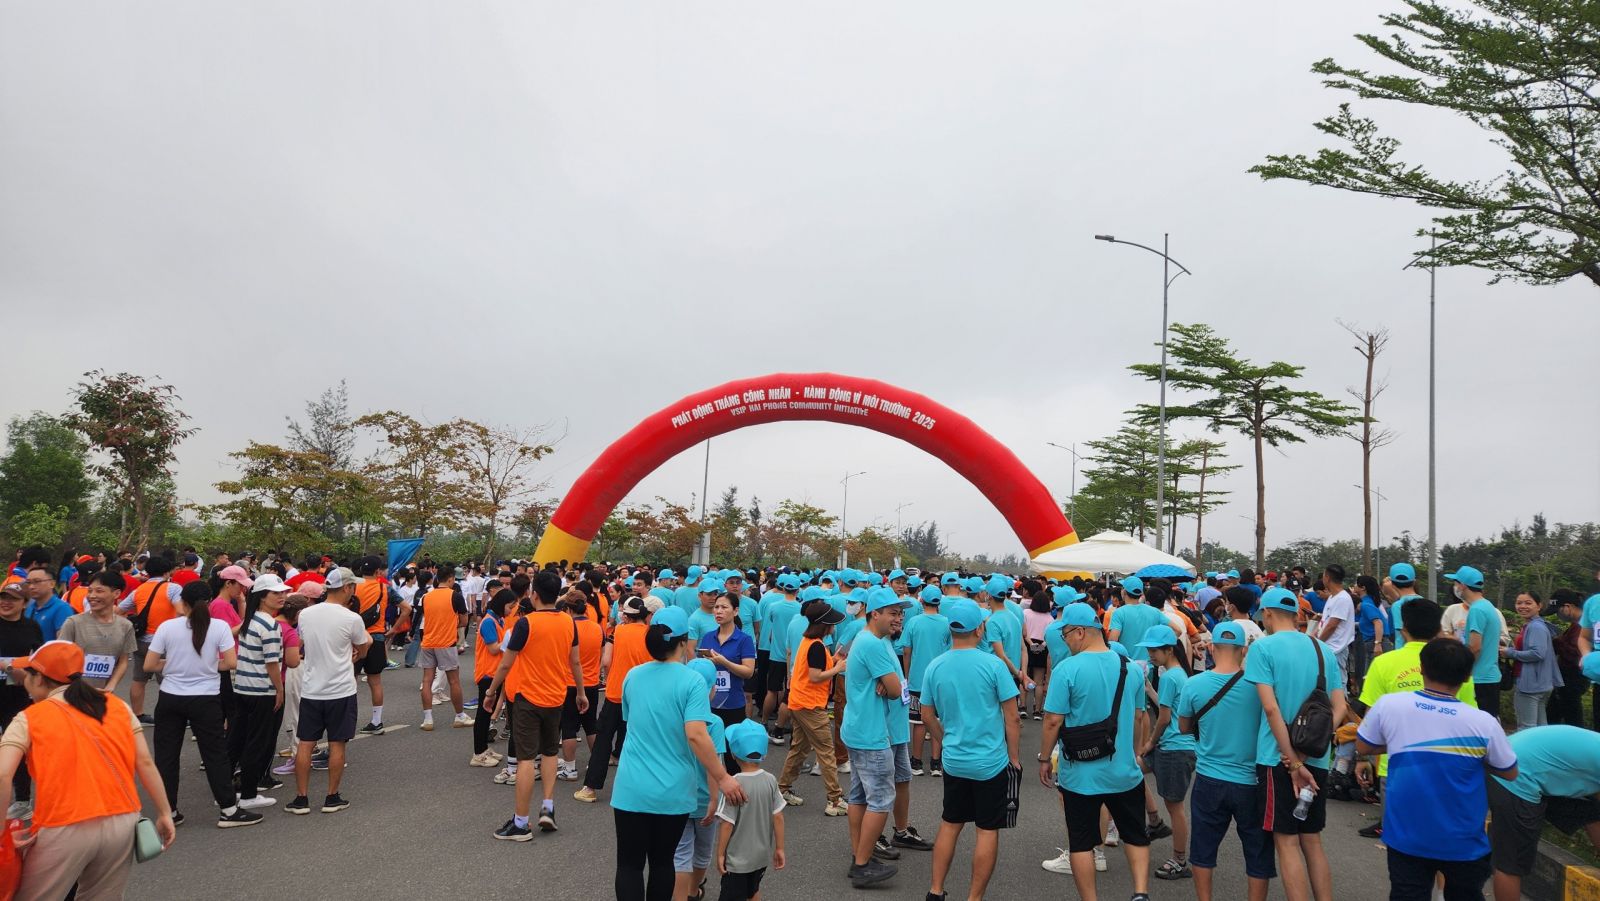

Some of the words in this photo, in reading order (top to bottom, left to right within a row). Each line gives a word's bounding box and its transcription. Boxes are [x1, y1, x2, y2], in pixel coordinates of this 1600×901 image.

[671, 411, 692, 428] PHÁT
[692, 402, 714, 419] ĐỘNG
[714, 394, 741, 411] THÁNG
[743, 389, 765, 403] CÔNG
[768, 386, 791, 400] NHÂN
[804, 385, 826, 399] HÀNH
[828, 388, 851, 403] ĐỘNG
[862, 394, 880, 408] MÔI
[879, 399, 912, 419] TRƯỜNG
[912, 411, 936, 430] 2025
[730, 406, 747, 416] VSIP
[789, 401, 832, 411] COMMUNITY
[833, 403, 869, 416] INITIATIVE
[86, 662, 110, 673] 0109
[1415, 701, 1436, 711] VSIP
[1438, 707, 1457, 716] JSC
